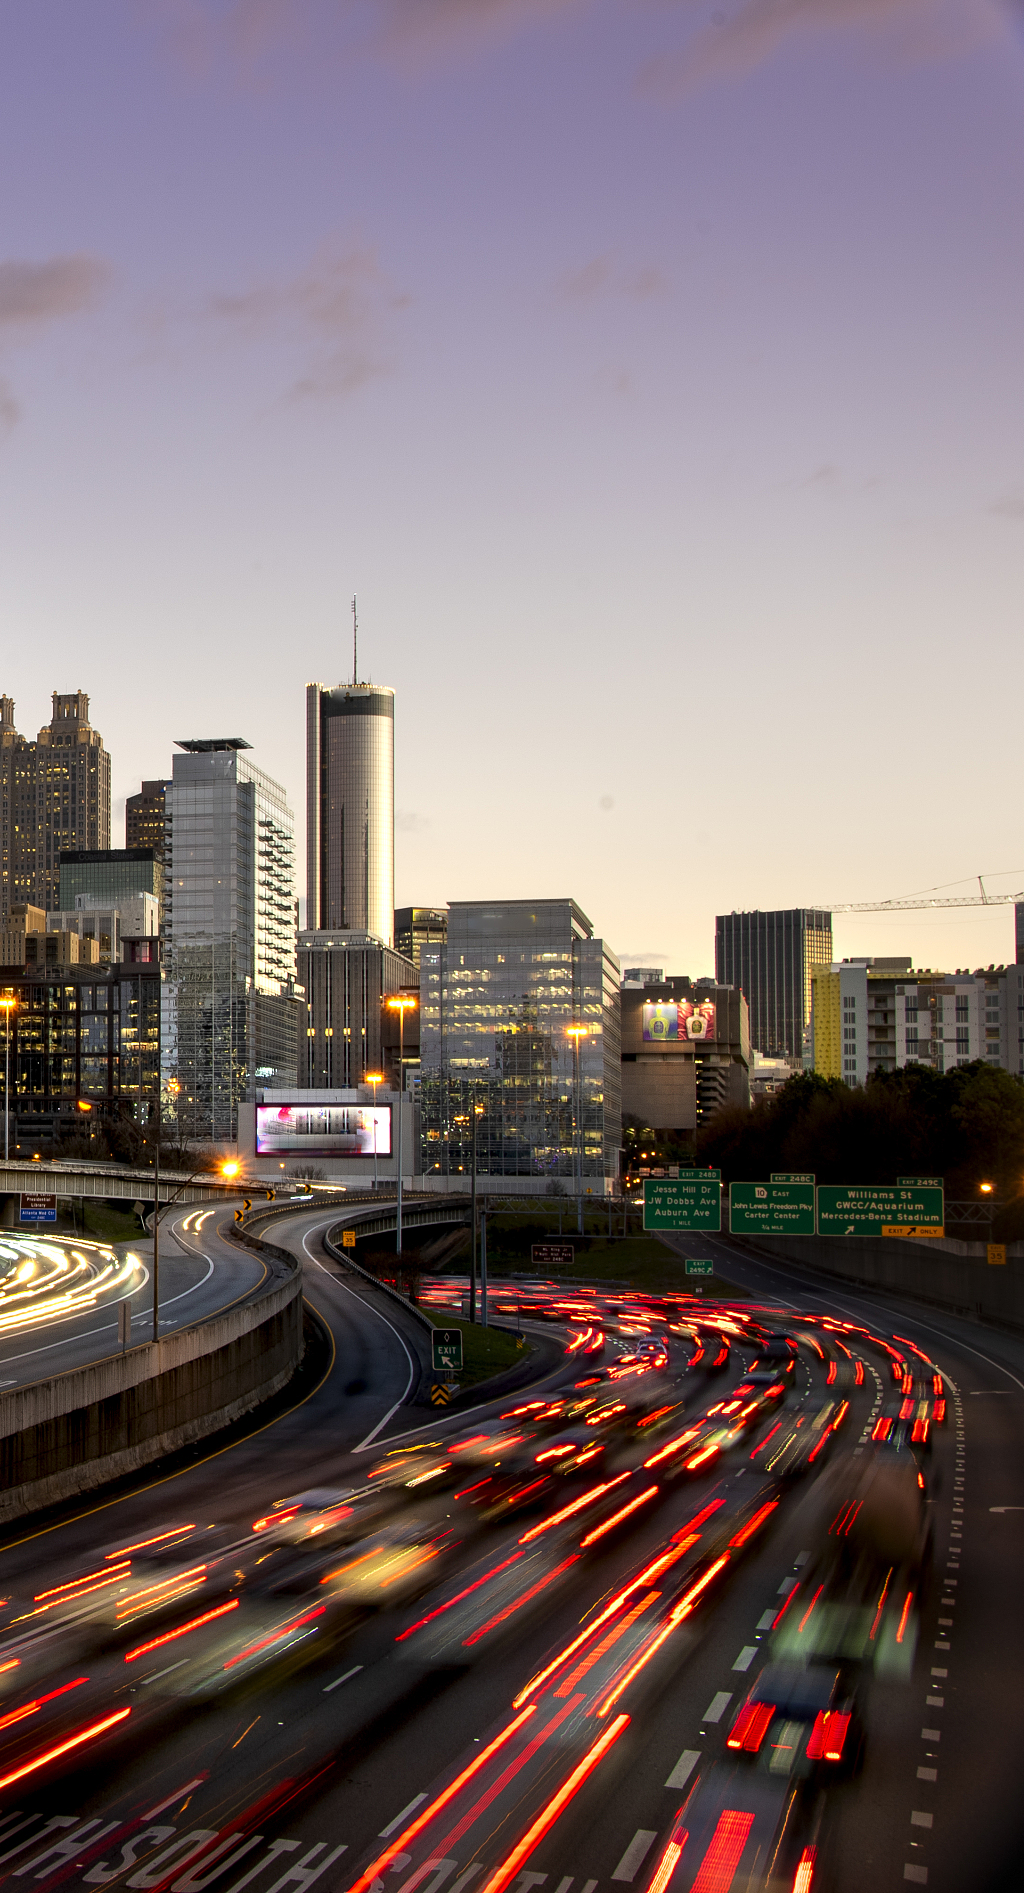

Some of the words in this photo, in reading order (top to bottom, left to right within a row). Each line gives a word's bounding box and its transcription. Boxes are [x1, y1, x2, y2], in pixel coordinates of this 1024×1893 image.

[110, 851, 134, 860] States
[701, 1186, 711, 1194] Dr
[848, 1191, 894, 1199] Williams
[900, 1191, 912, 1199] St
[648, 1197, 662, 1205] JW
[667, 1197, 694, 1205] Dobbs
[799, 1203, 813, 1211] Pky
[836, 1201, 924, 1211] GWCC/Aquarium
[655, 1208, 688, 1216] Auburn
[821, 1212, 892, 1221] Mercedes-Benz
[897, 1213, 939, 1221] Stadium
[990, 1252, 1002, 1260] 35
[438, 1346, 456, 1354] EXIT
[83, 1825, 349, 1893] SOUTH
